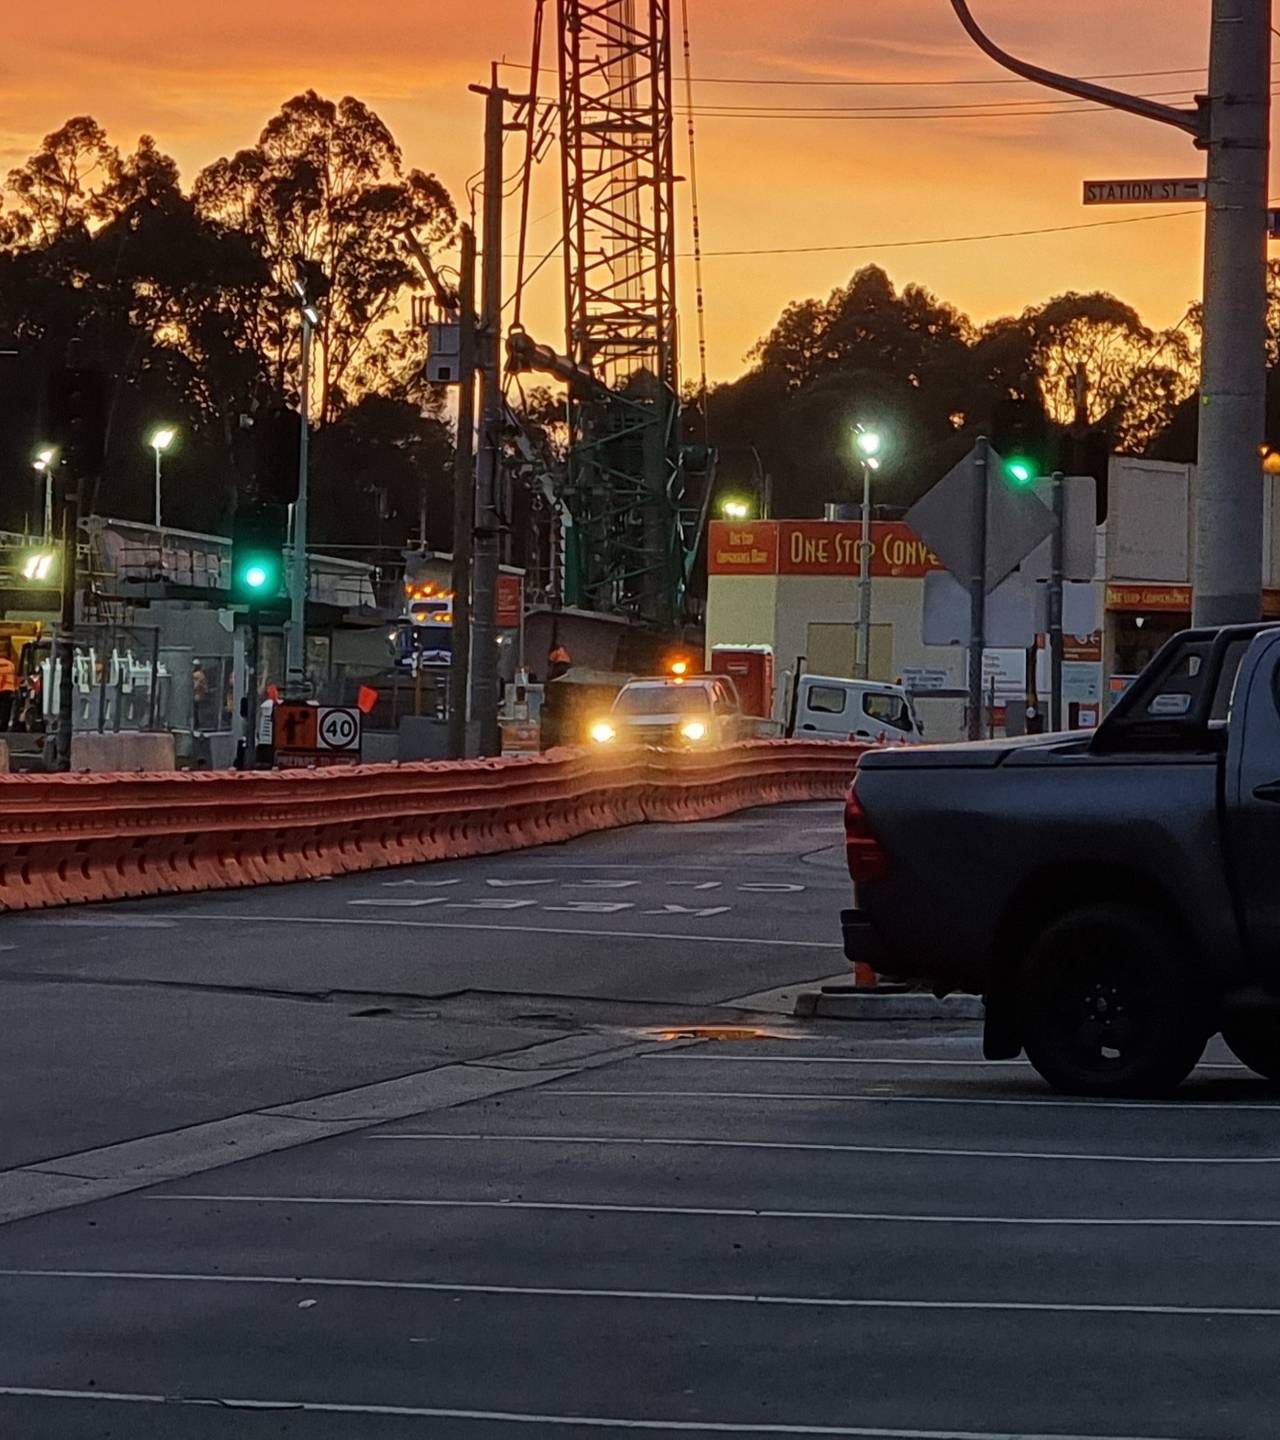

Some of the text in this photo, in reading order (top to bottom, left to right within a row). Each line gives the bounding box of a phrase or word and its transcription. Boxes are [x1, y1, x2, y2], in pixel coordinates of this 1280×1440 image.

[1087, 183, 1179, 201] STATION ST
[325, 720, 352, 738] 40
